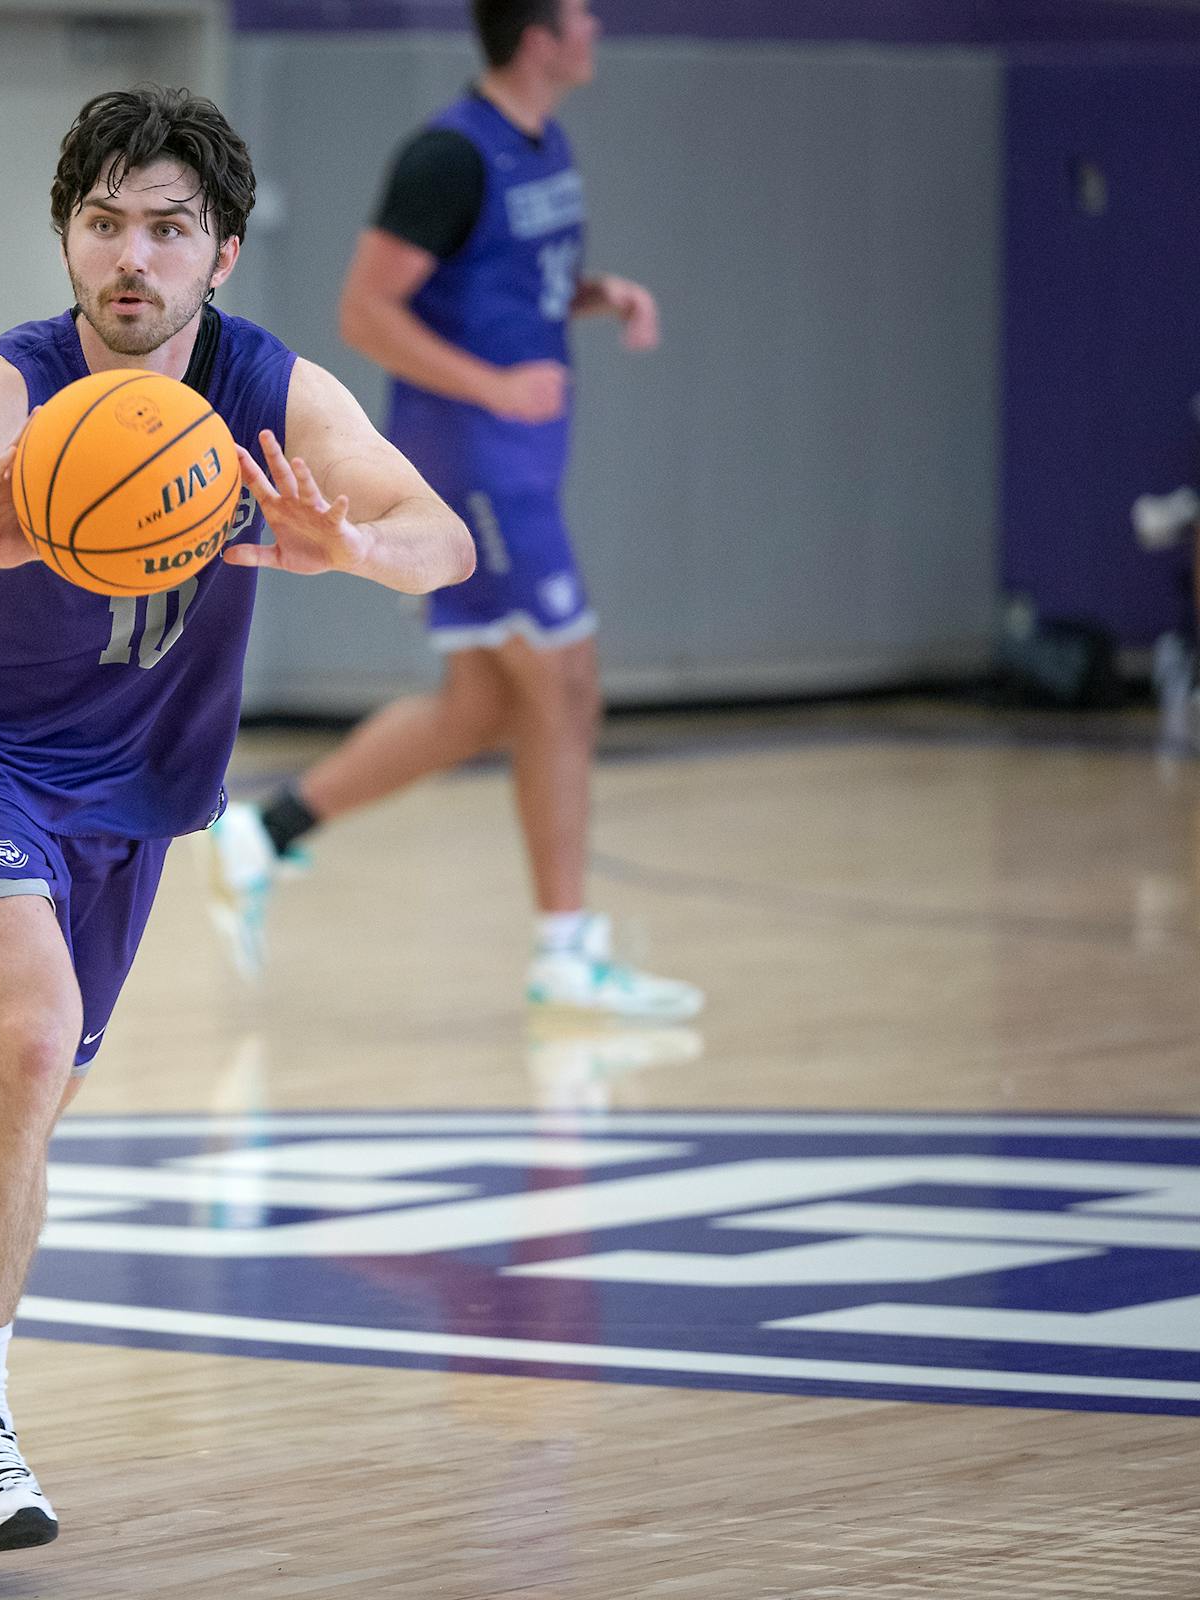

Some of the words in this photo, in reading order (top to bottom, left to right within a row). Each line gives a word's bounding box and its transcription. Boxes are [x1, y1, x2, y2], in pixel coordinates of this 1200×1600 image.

[162, 447, 222, 514] EVO
[136, 508, 162, 530] NXT
[143, 519, 230, 576] ilson
[98, 575, 200, 670] 10
